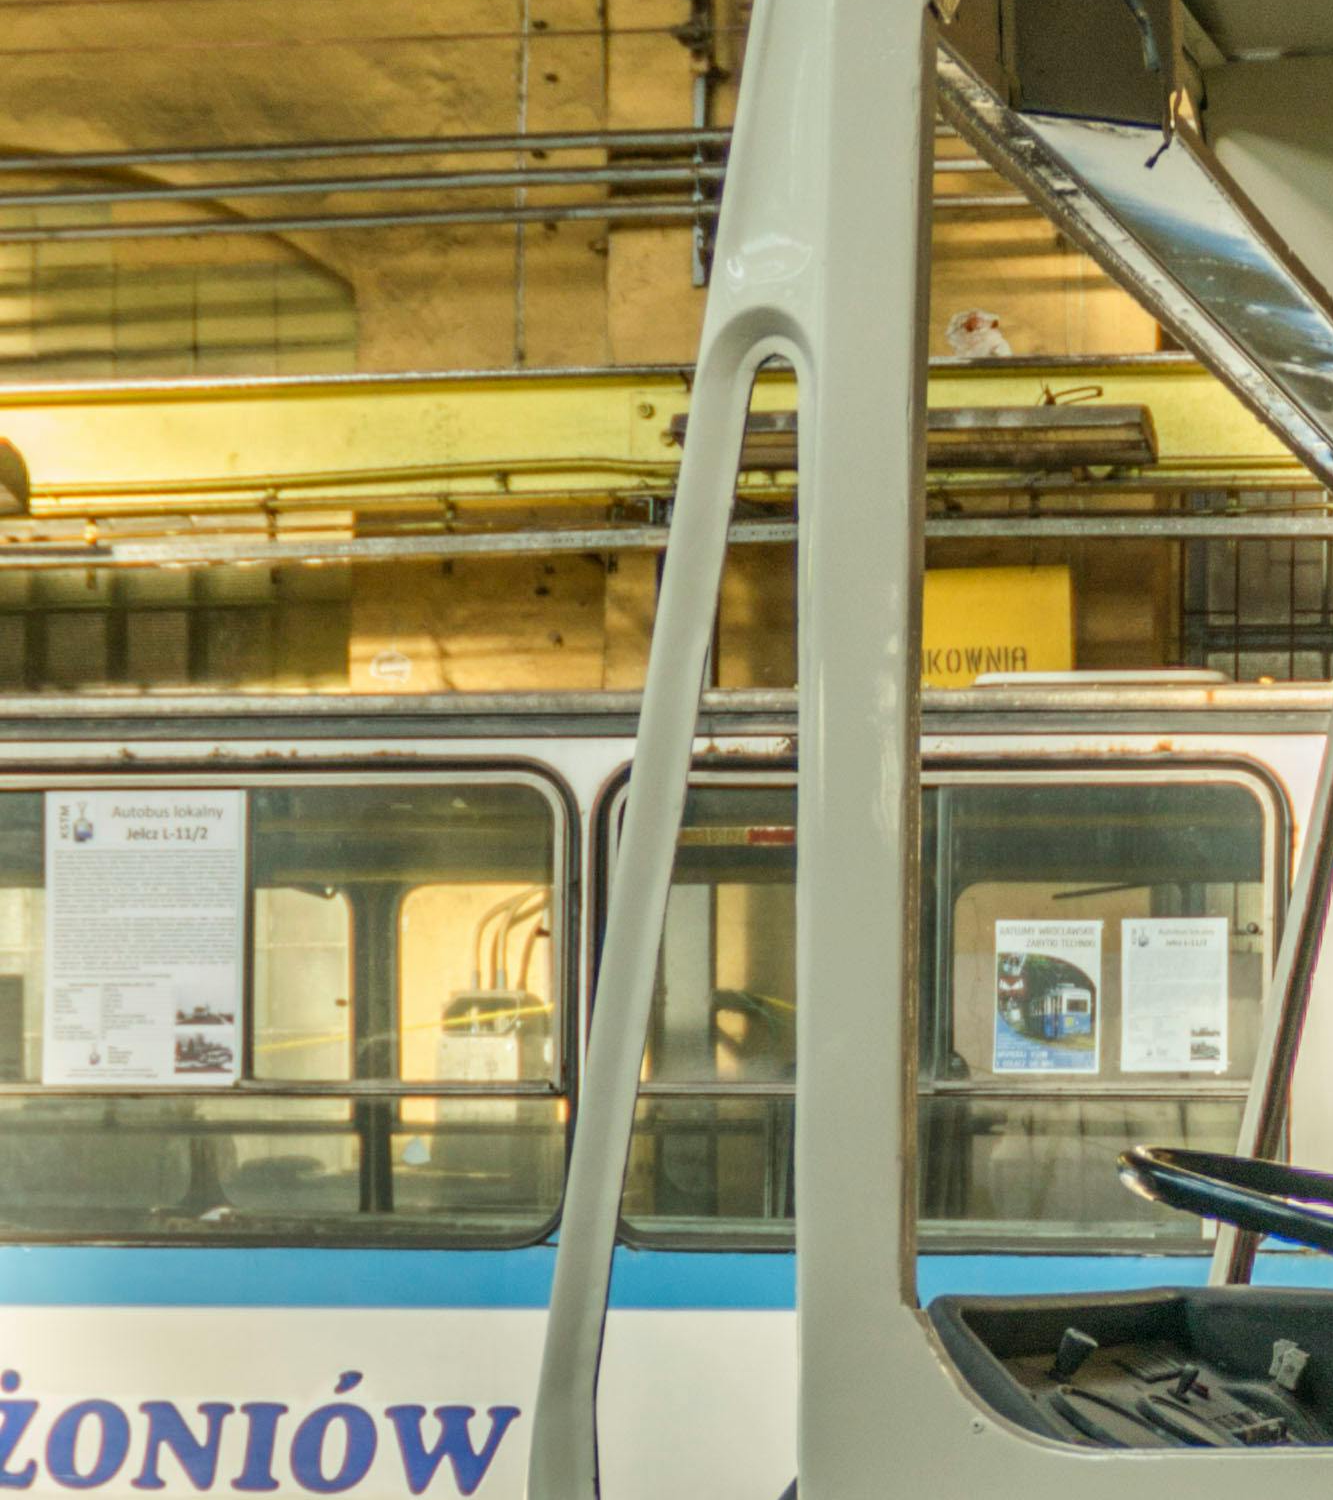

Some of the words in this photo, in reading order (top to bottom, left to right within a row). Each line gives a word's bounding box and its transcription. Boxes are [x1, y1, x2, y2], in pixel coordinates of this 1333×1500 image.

[922, 645, 1027, 675] KOWNIA
[111, 806, 170, 819] Autobus
[173, 805, 224, 820] lokalny
[126, 826, 159, 841] Jelcz
[162, 826, 209, 841] L-11/2
